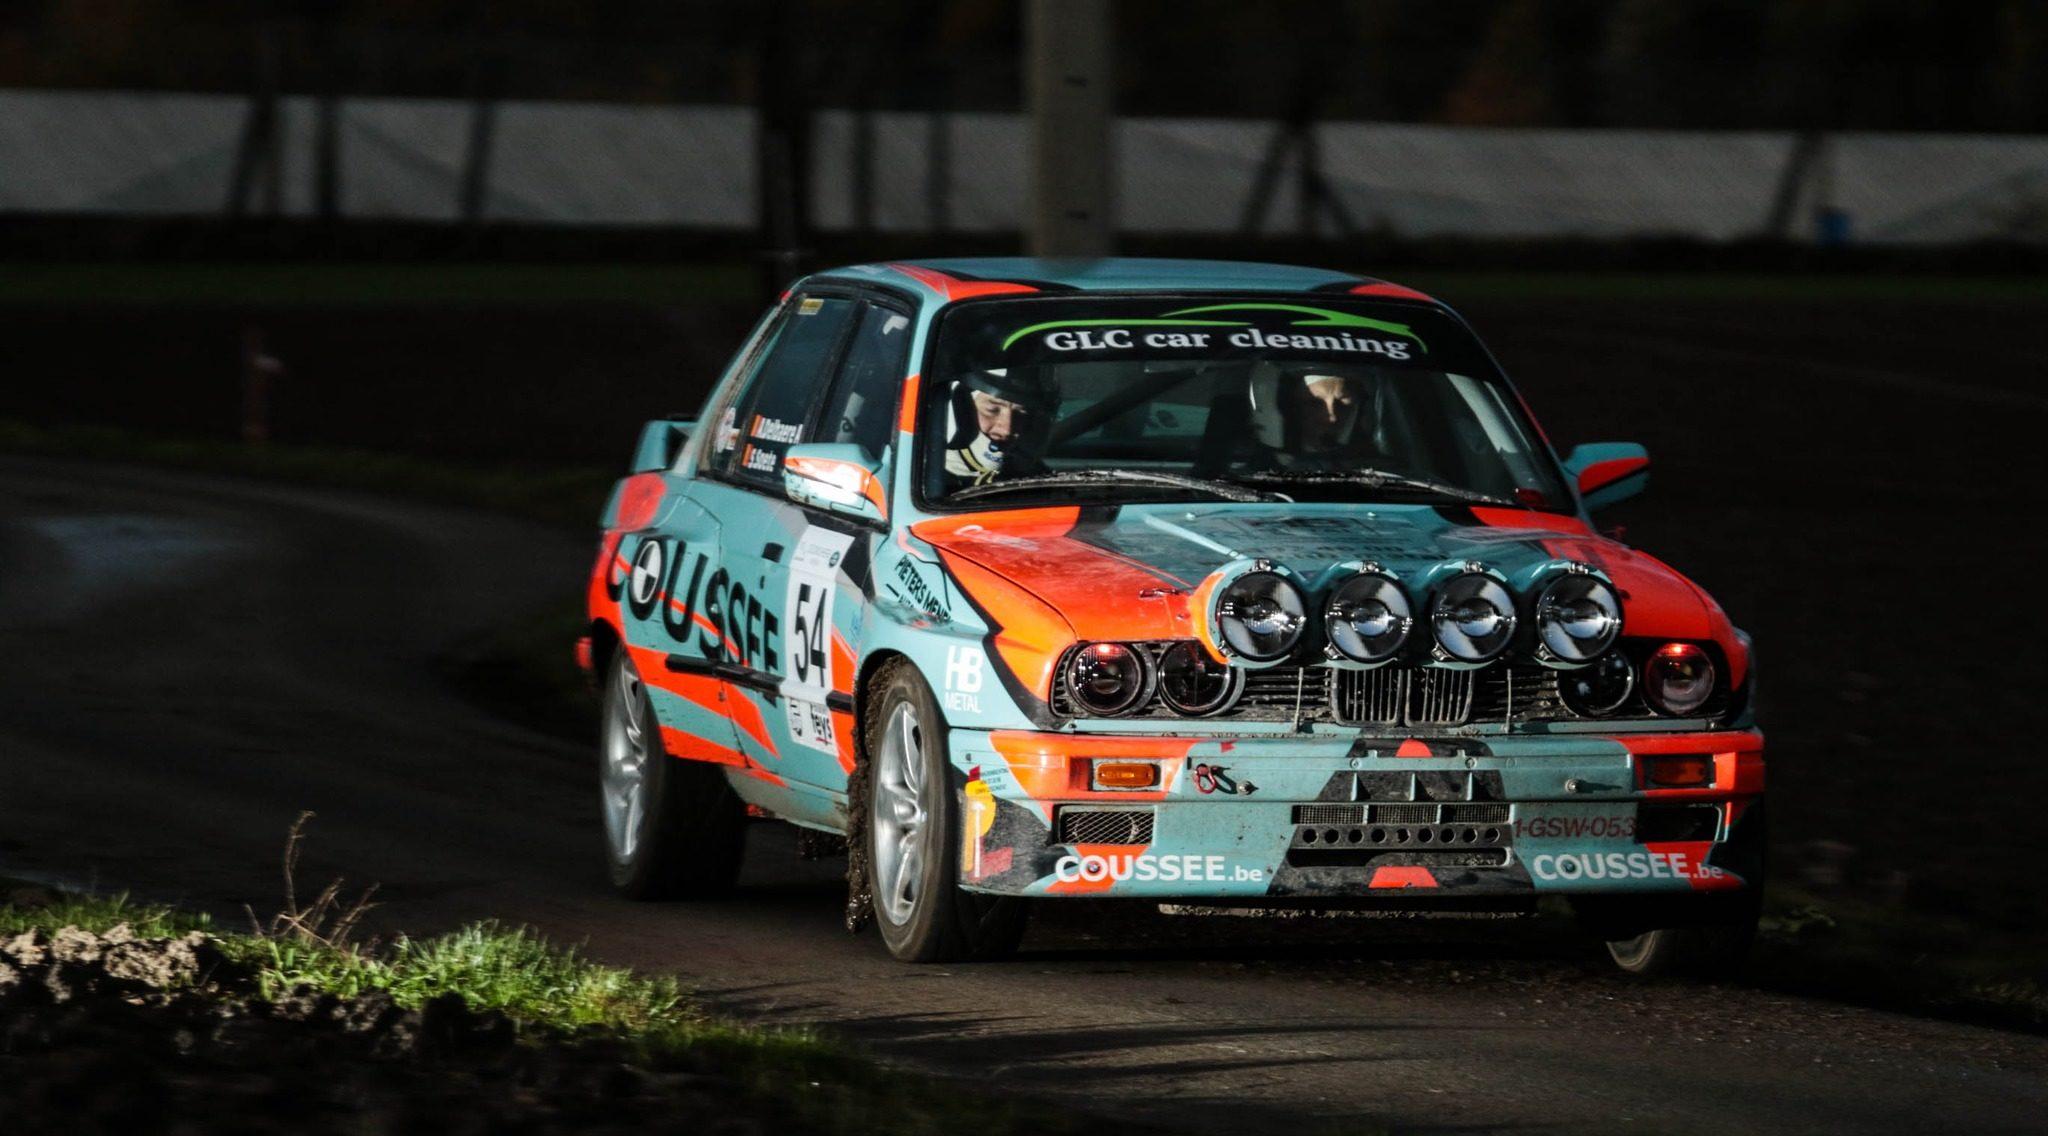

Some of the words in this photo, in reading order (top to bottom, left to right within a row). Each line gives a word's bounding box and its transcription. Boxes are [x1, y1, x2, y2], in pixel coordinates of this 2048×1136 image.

[1044, 329, 1134, 351] GLC
[1144, 332, 1209, 349] car
[1228, 328, 1411, 360] cleaning
[894, 555, 927, 603] PIETERS
[795, 583, 827, 688] 54
[945, 645, 984, 692] HB
[943, 692, 983, 714] METAL
[1515, 815, 1637, 839] 1-GSW-053
[1055, 855, 1263, 883] COUSSEE.be
[1533, 852, 1724, 881] COUSSEE.be
